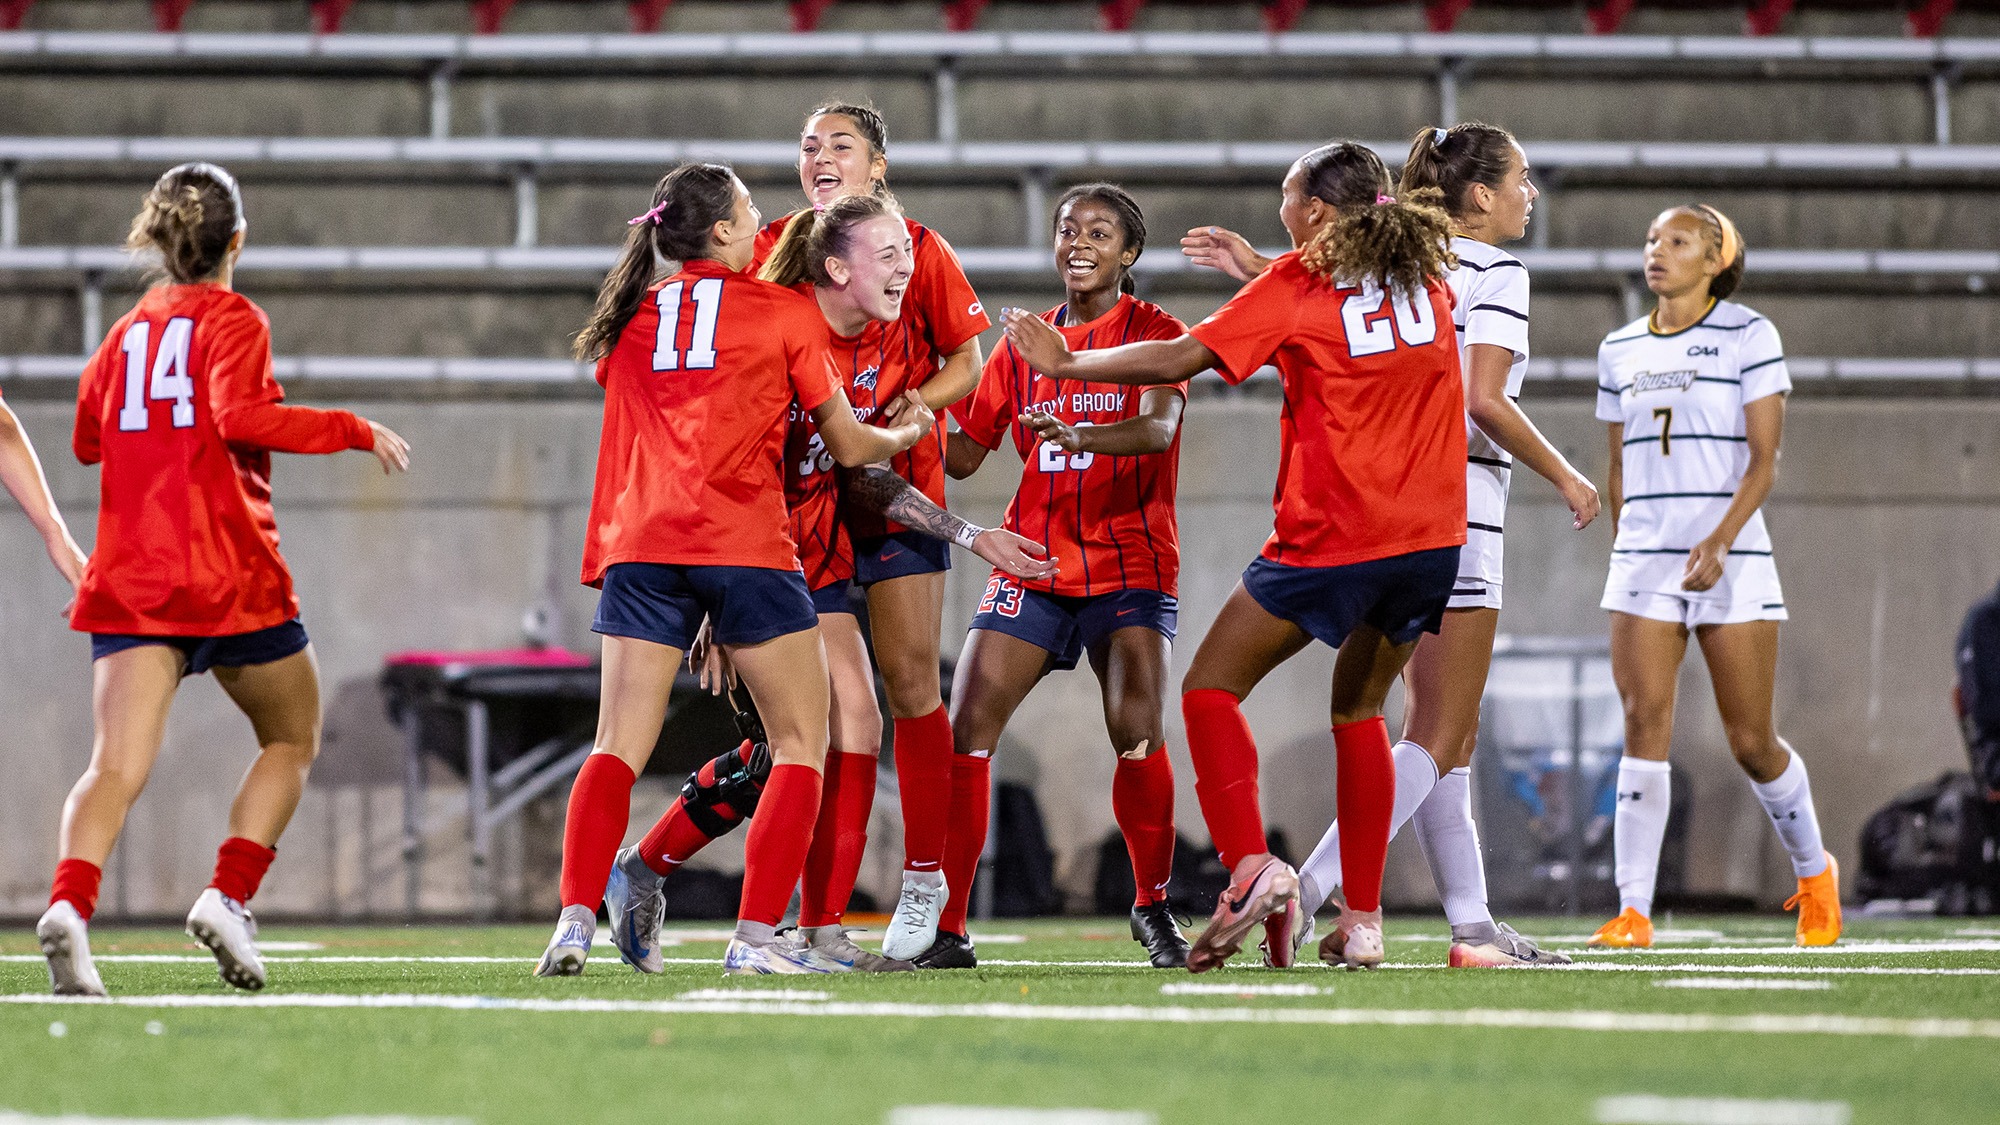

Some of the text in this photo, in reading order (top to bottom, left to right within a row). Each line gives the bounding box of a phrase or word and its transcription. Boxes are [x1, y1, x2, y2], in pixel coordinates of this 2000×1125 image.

[652, 278, 724, 372] 11
[1335, 266, 1437, 358] 20
[119, 316, 195, 432] 14
[1687, 345, 1719, 357] CAA
[1072, 392, 1126, 413] BROOK
[1653, 407, 1673, 456] 7
[977, 578, 1026, 618] 23
